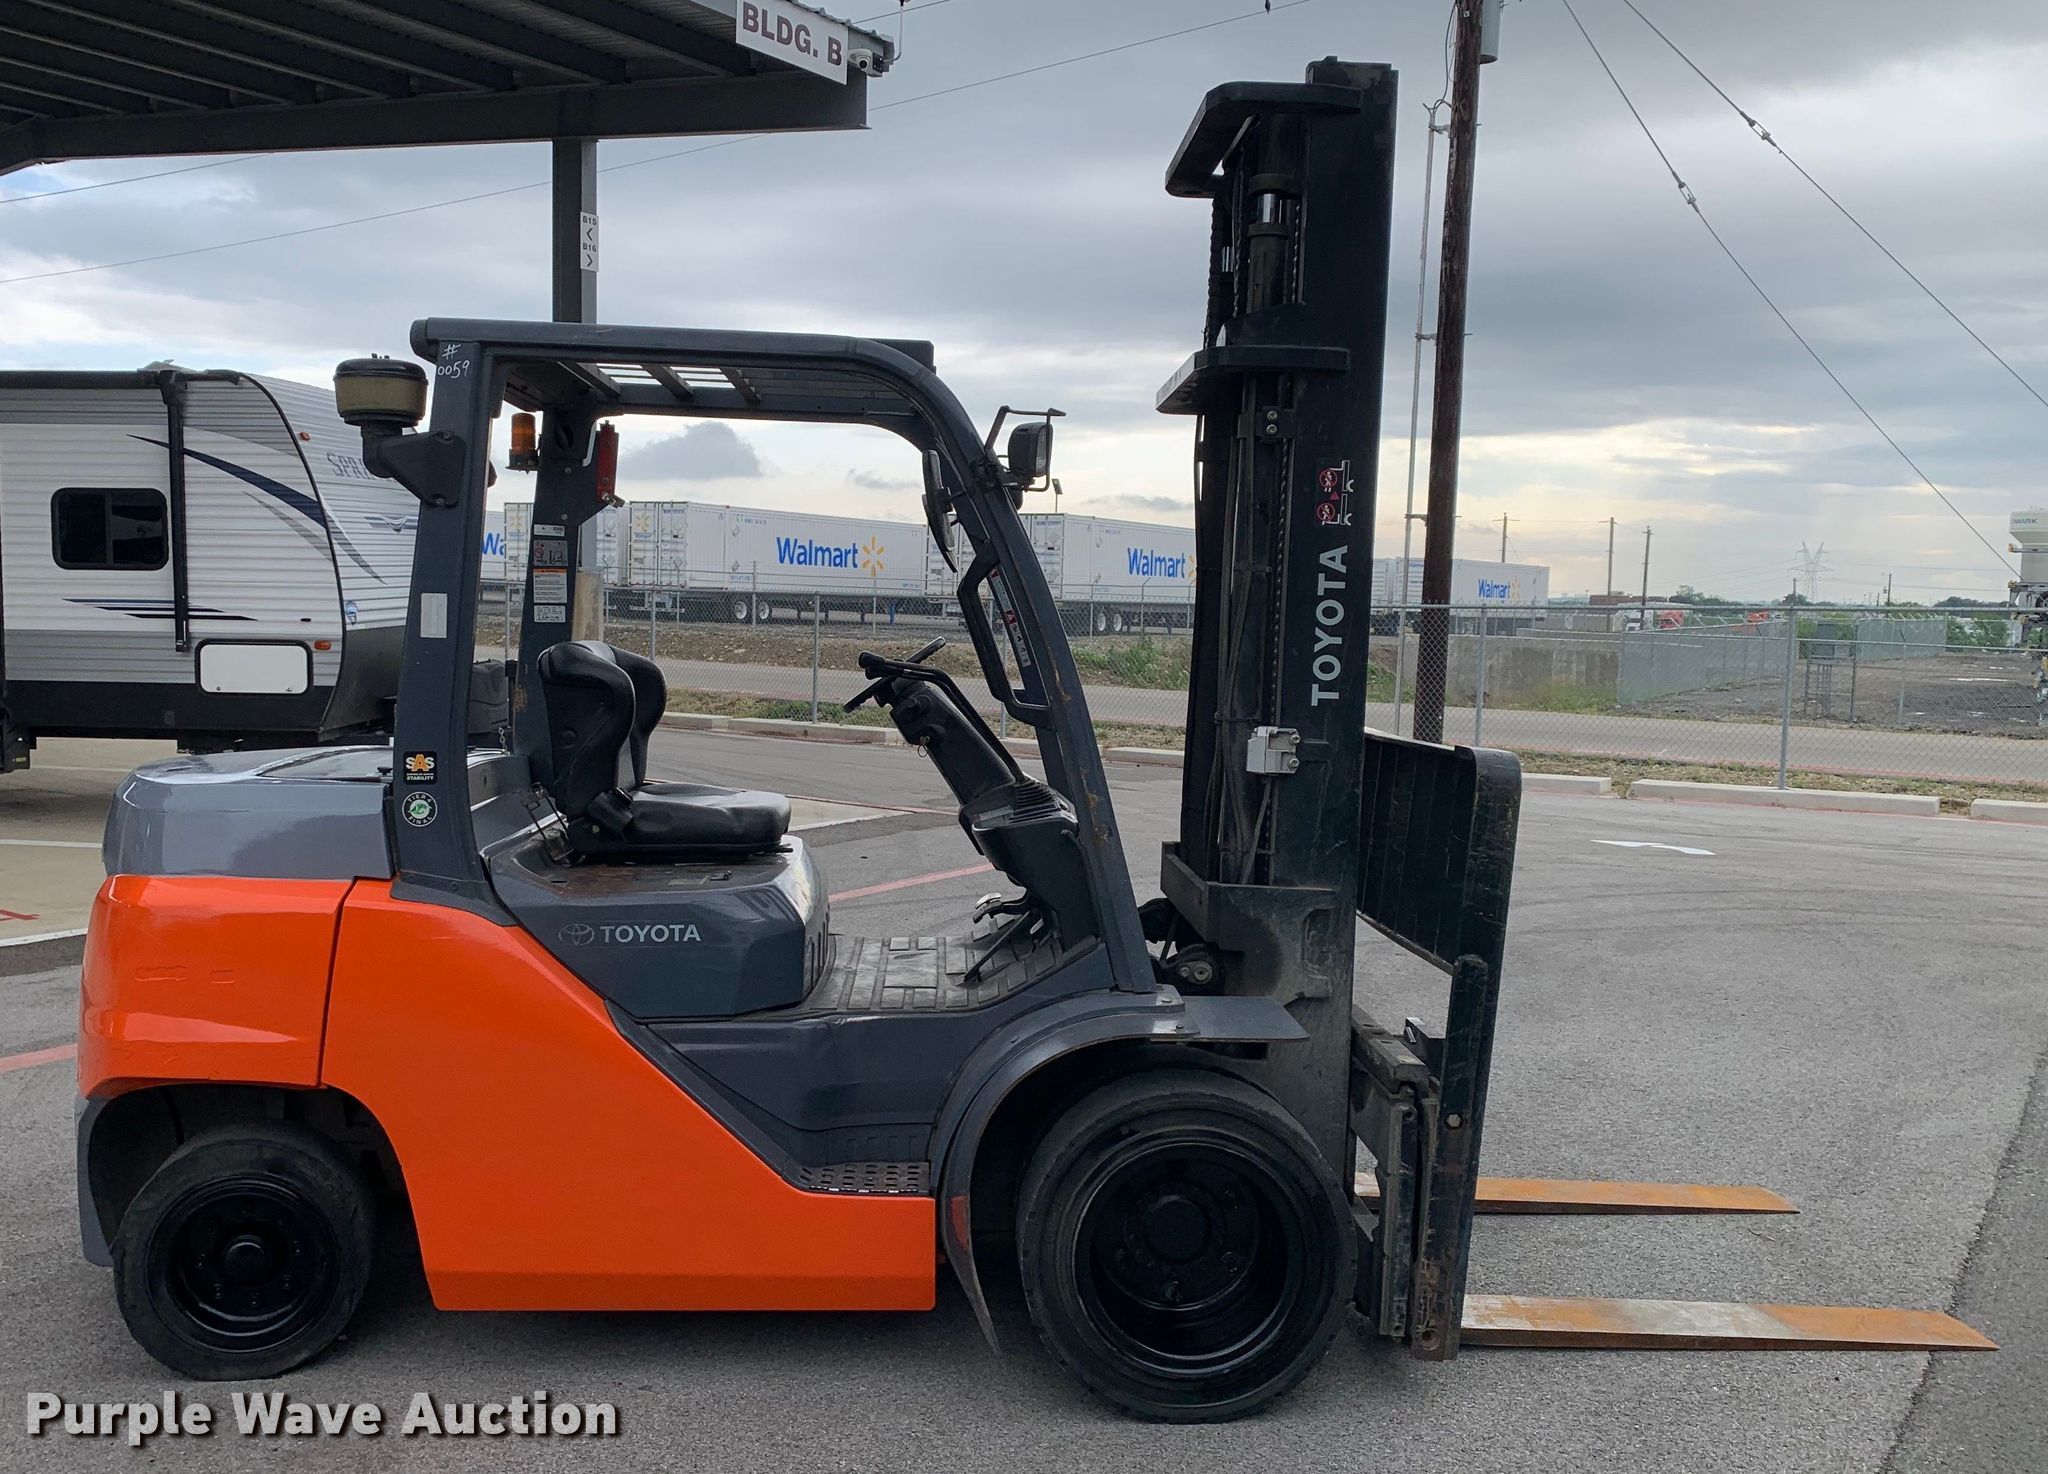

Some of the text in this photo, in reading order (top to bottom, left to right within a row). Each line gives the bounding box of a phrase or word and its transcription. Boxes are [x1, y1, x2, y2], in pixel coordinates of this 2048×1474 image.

[742, 2, 842, 66] BLDG. B
[442, 344, 462, 360] #
[437, 360, 470, 379] 0059
[326, 451, 377, 480] SPRI
[776, 536, 858, 569] Walmart
[1127, 547, 1186, 579] Walmart
[1478, 578, 1511, 599] Walmart
[1310, 545, 1349, 707] TOYOTA
[405, 753, 435, 772] SAS
[600, 924, 701, 943] TOYOTA
